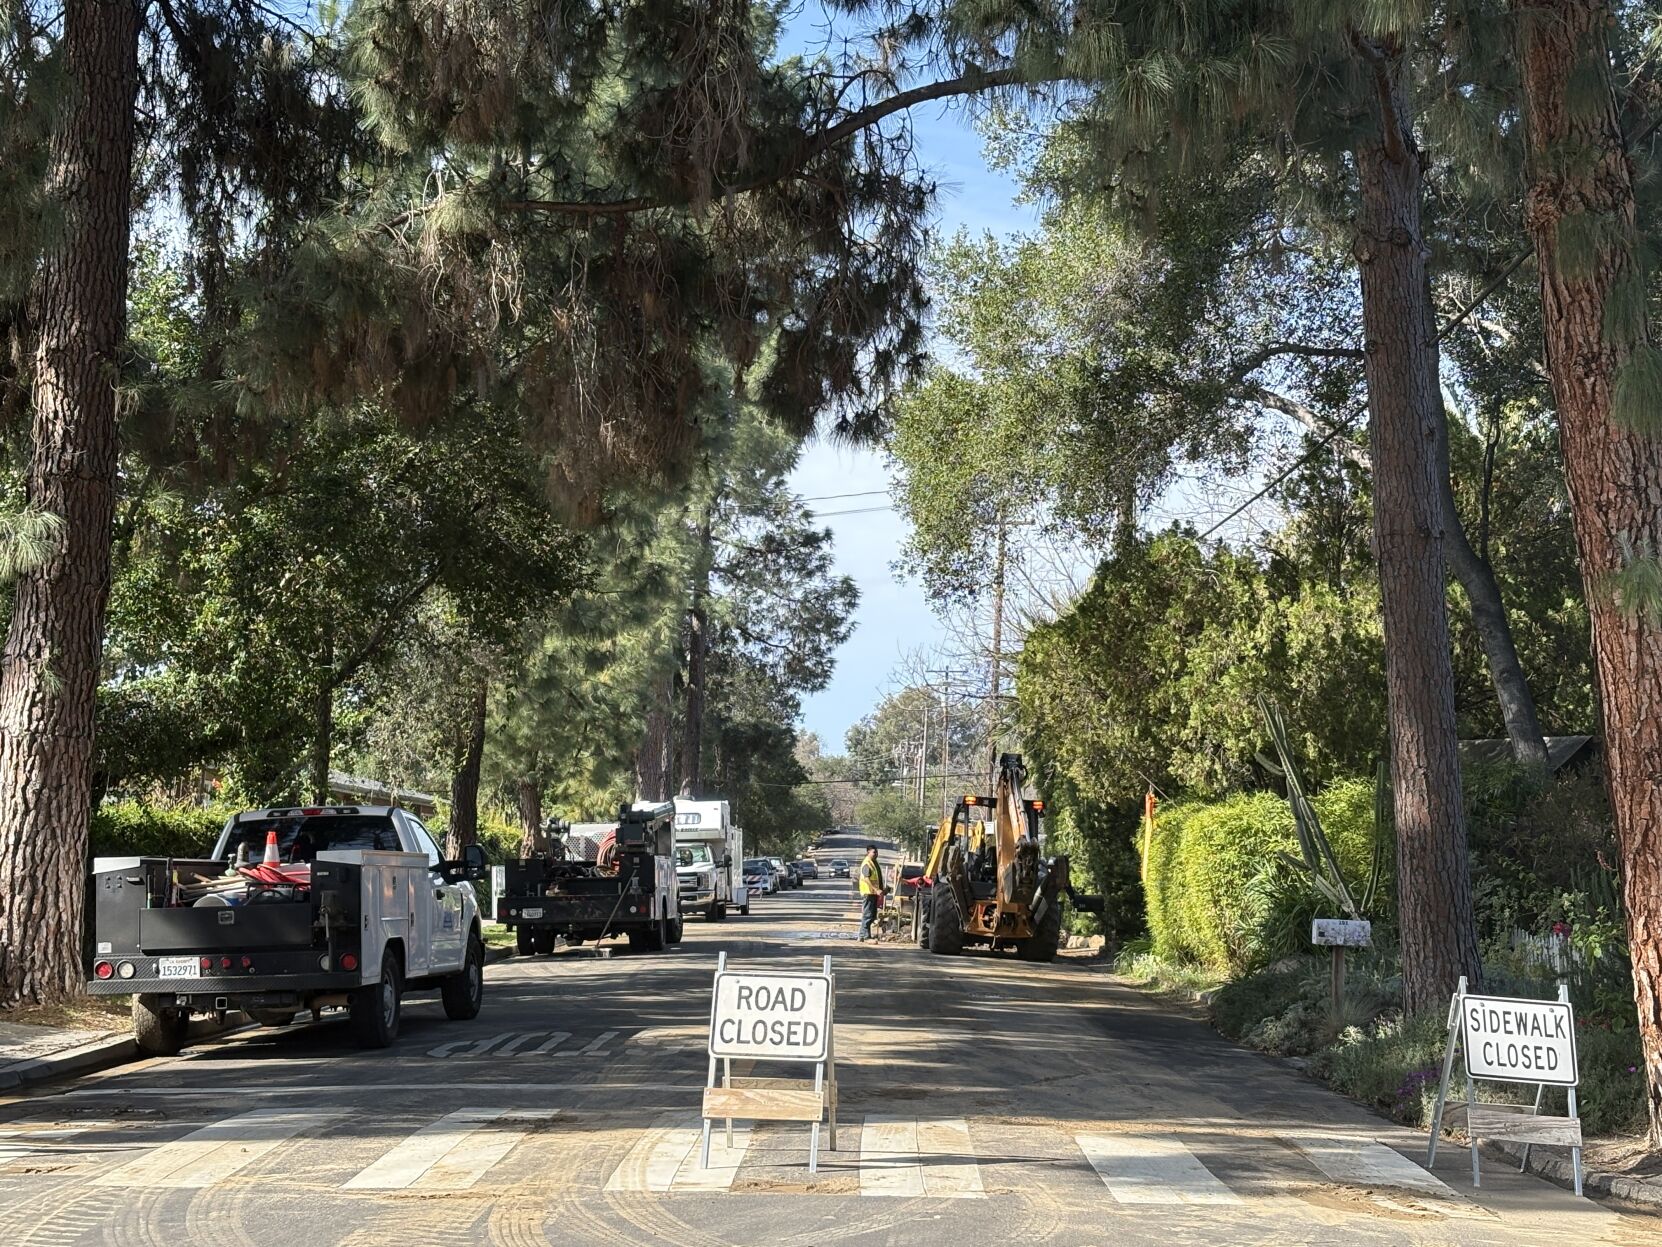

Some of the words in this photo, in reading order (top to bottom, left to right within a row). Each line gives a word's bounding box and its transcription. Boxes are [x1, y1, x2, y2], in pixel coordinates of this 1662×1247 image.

[162, 965, 197, 977] 1532971
[736, 985, 806, 1012] ROAD
[719, 1018, 819, 1047] CLOSED
[1470, 1007, 1566, 1039] SIDEWALK
[1483, 1041, 1558, 1071] CLOSED
